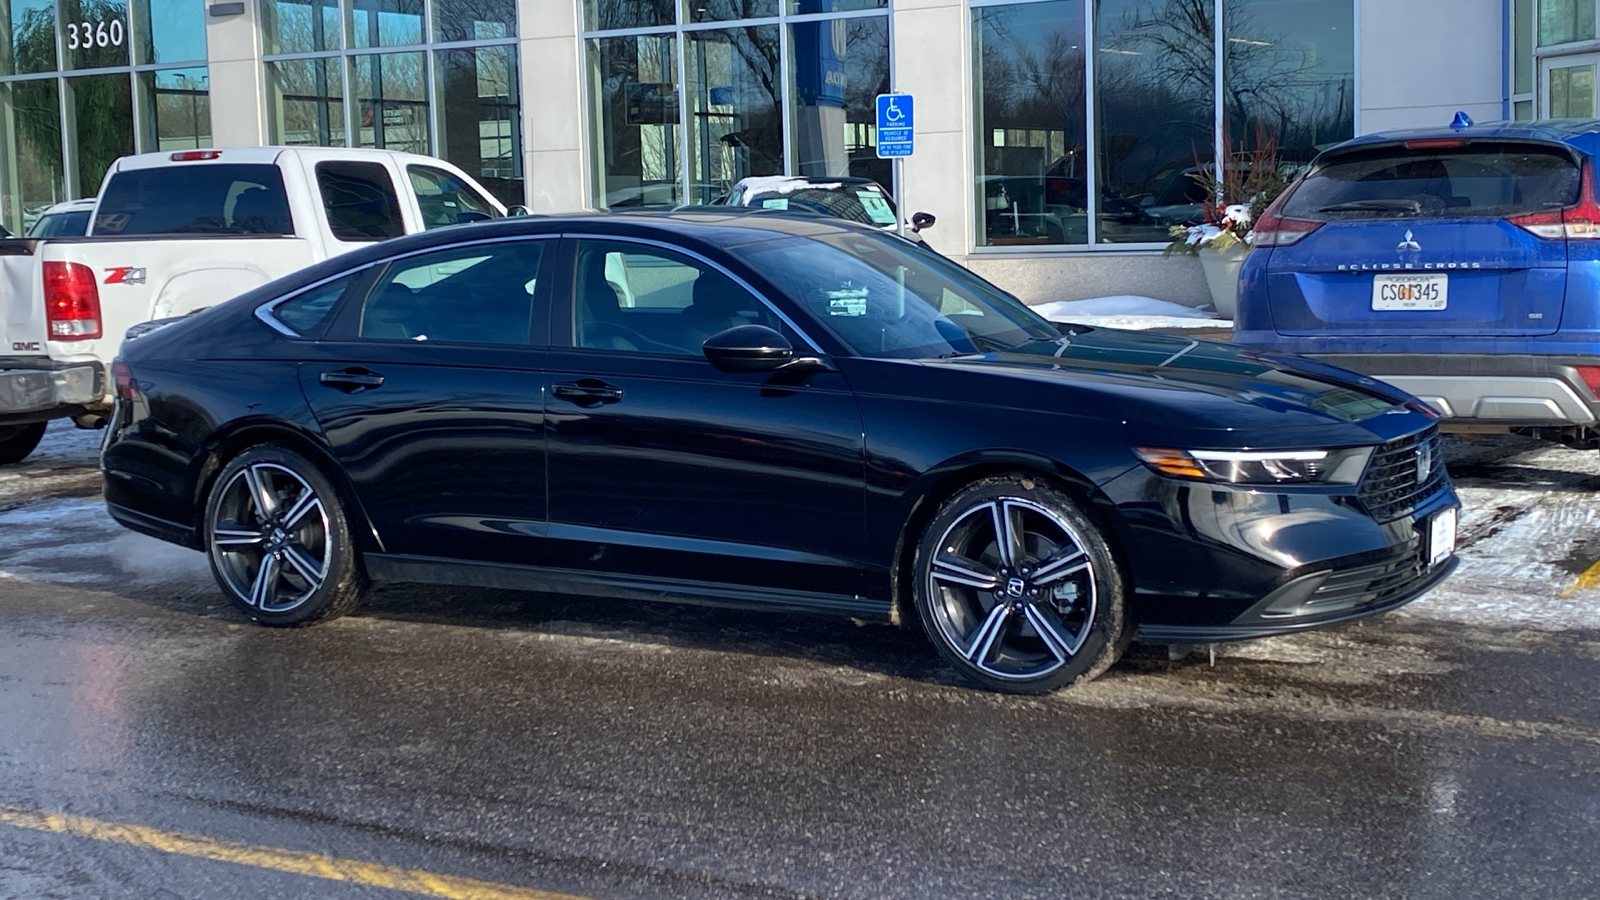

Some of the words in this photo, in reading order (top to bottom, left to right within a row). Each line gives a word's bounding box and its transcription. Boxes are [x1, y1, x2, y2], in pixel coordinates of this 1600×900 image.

[67, 20, 123, 49] 3360
[1338, 263, 1414, 271] ECLIPSE
[12, 342, 40, 351] GMC
